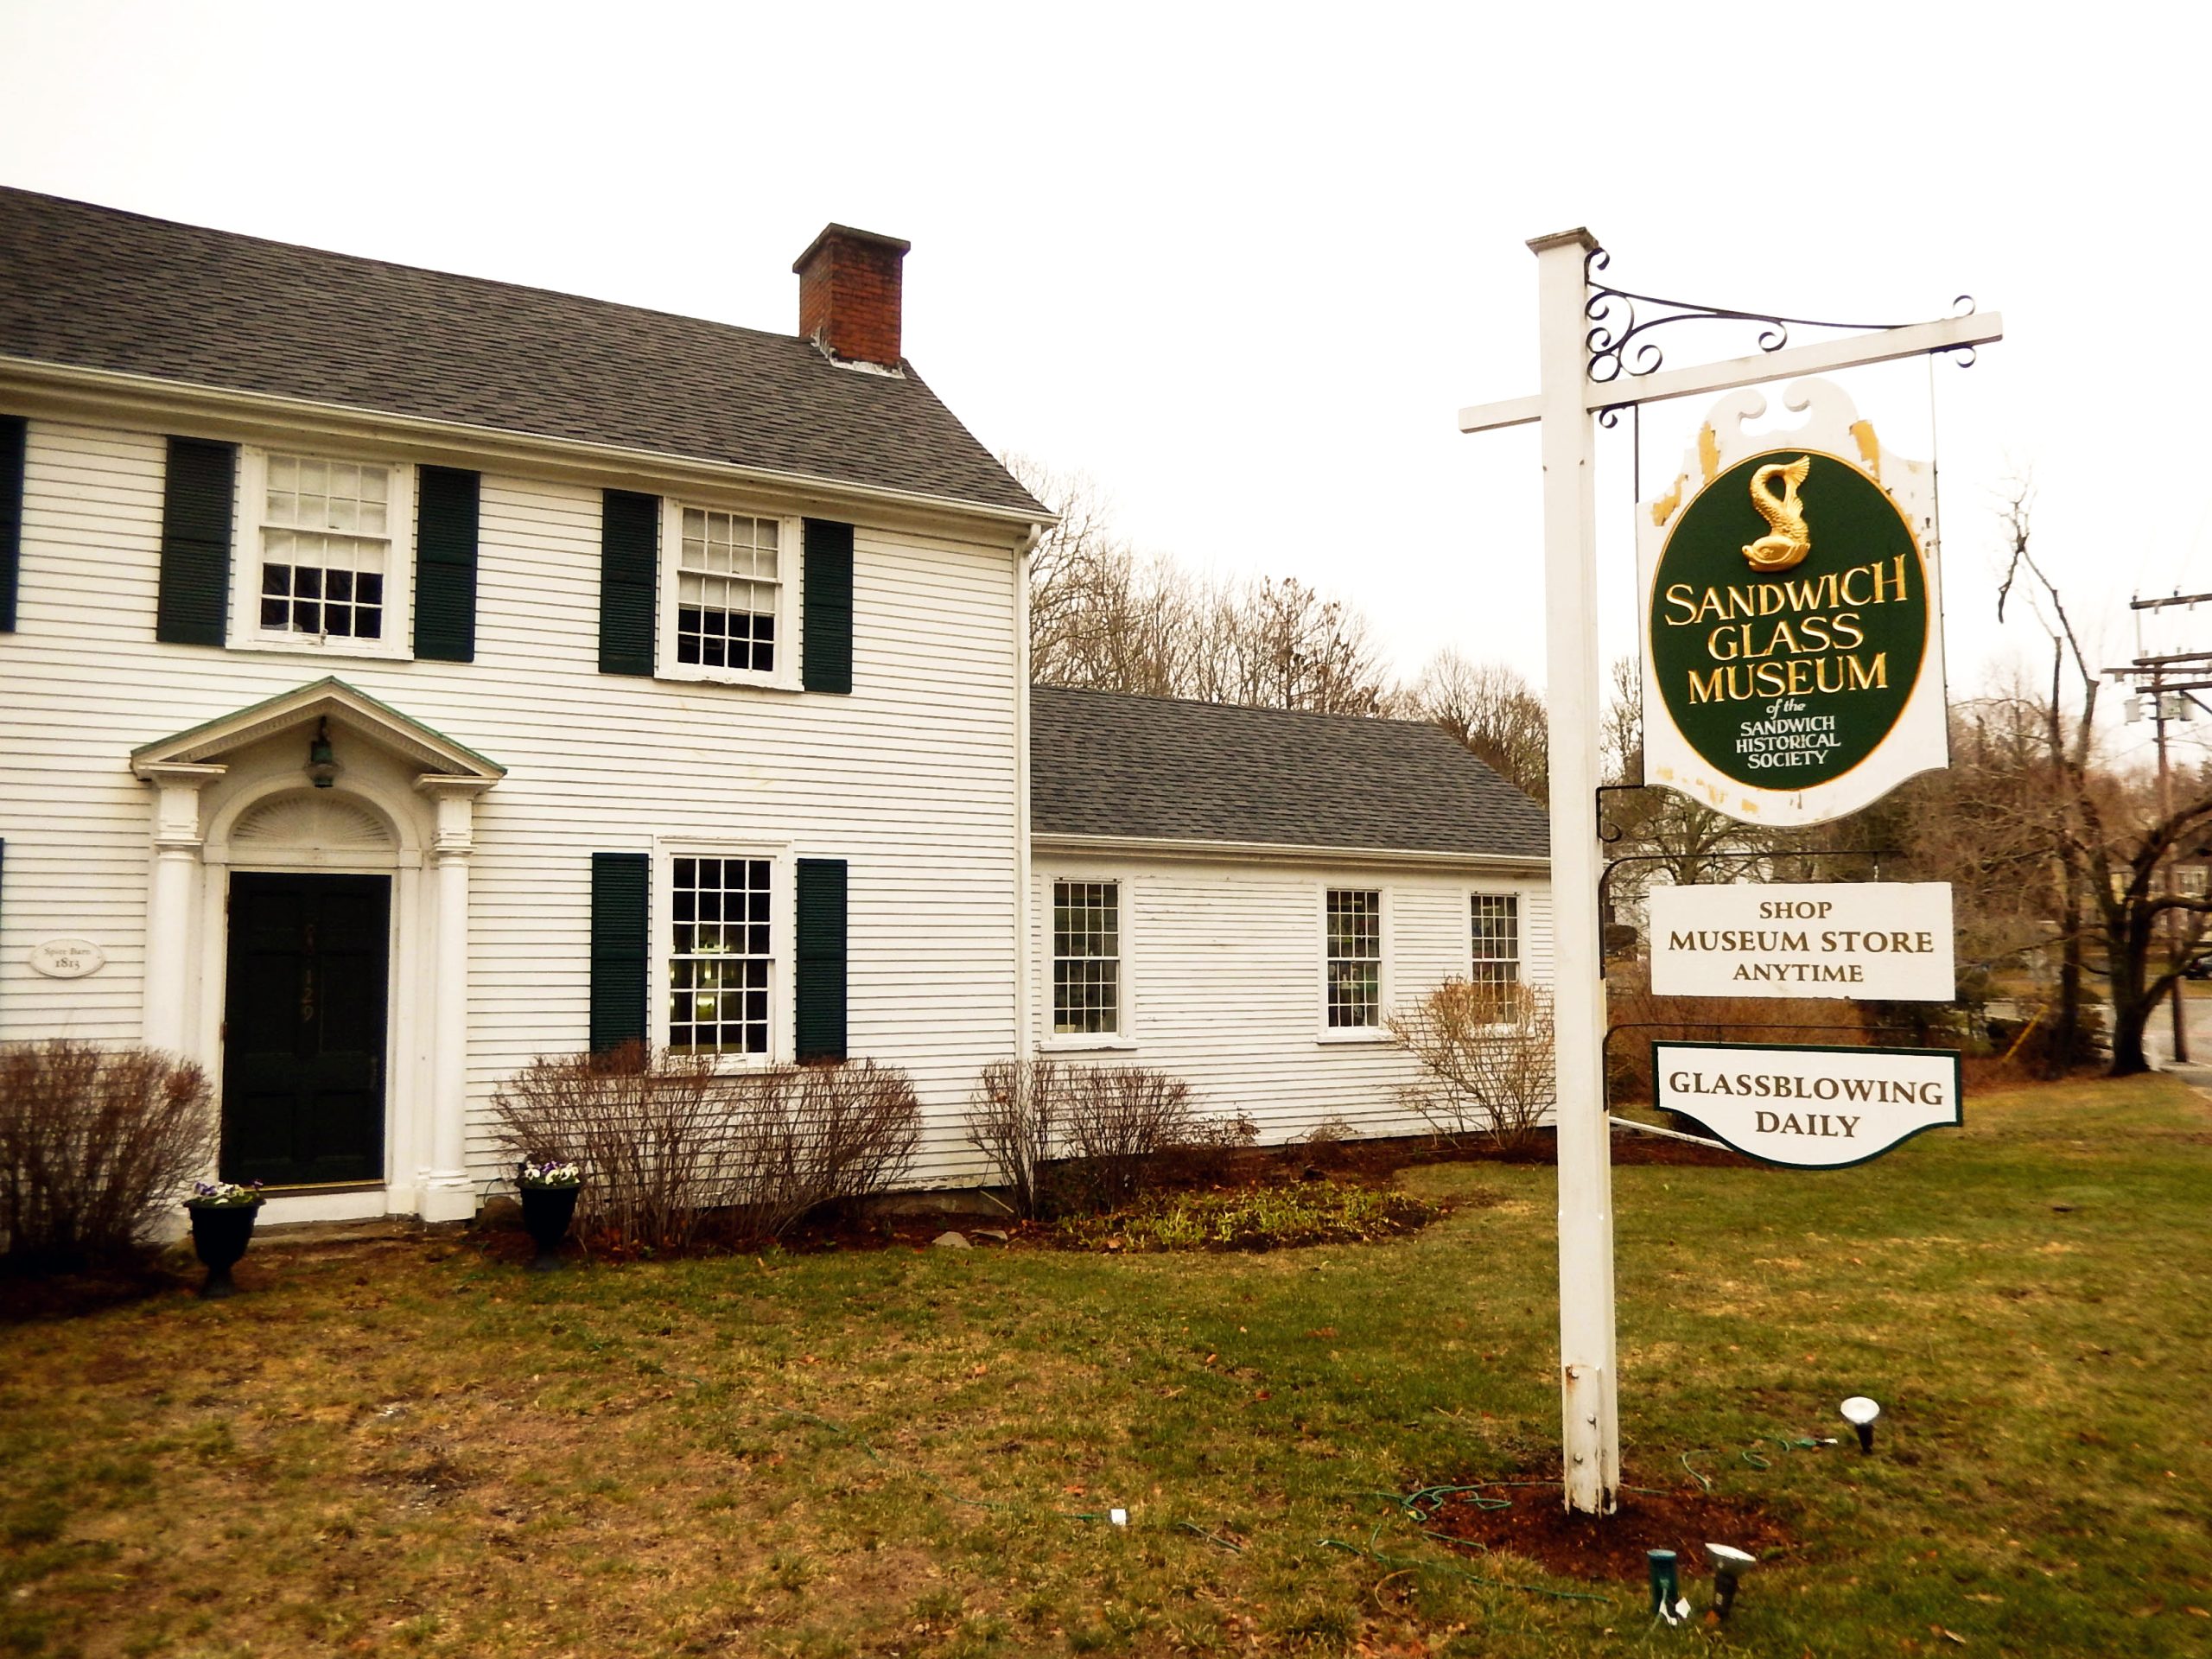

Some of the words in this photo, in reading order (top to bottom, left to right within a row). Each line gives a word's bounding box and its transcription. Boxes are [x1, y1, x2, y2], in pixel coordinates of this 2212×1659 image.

[1664, 553, 1908, 626] SANDWICH
[1707, 613, 1865, 661] GLASS
[1688, 652, 1889, 705] MUSEUM
[1766, 700, 1783, 719] of
[1783, 698, 1806, 713] the
[1740, 715, 1835, 736] SANDWICH
[1735, 734, 1841, 753] HISTORICAL
[1747, 749, 1829, 769] SOCIETY
[1759, 901, 1833, 919] SHOP
[1669, 931, 1810, 952] MUSEUM
[1821, 931, 1935, 954] STORE
[1732, 963, 1865, 983] ANYTIME
[1669, 1071, 1944, 1106] GLASSBLOWING
[1756, 1111, 1860, 1138] DAILY
